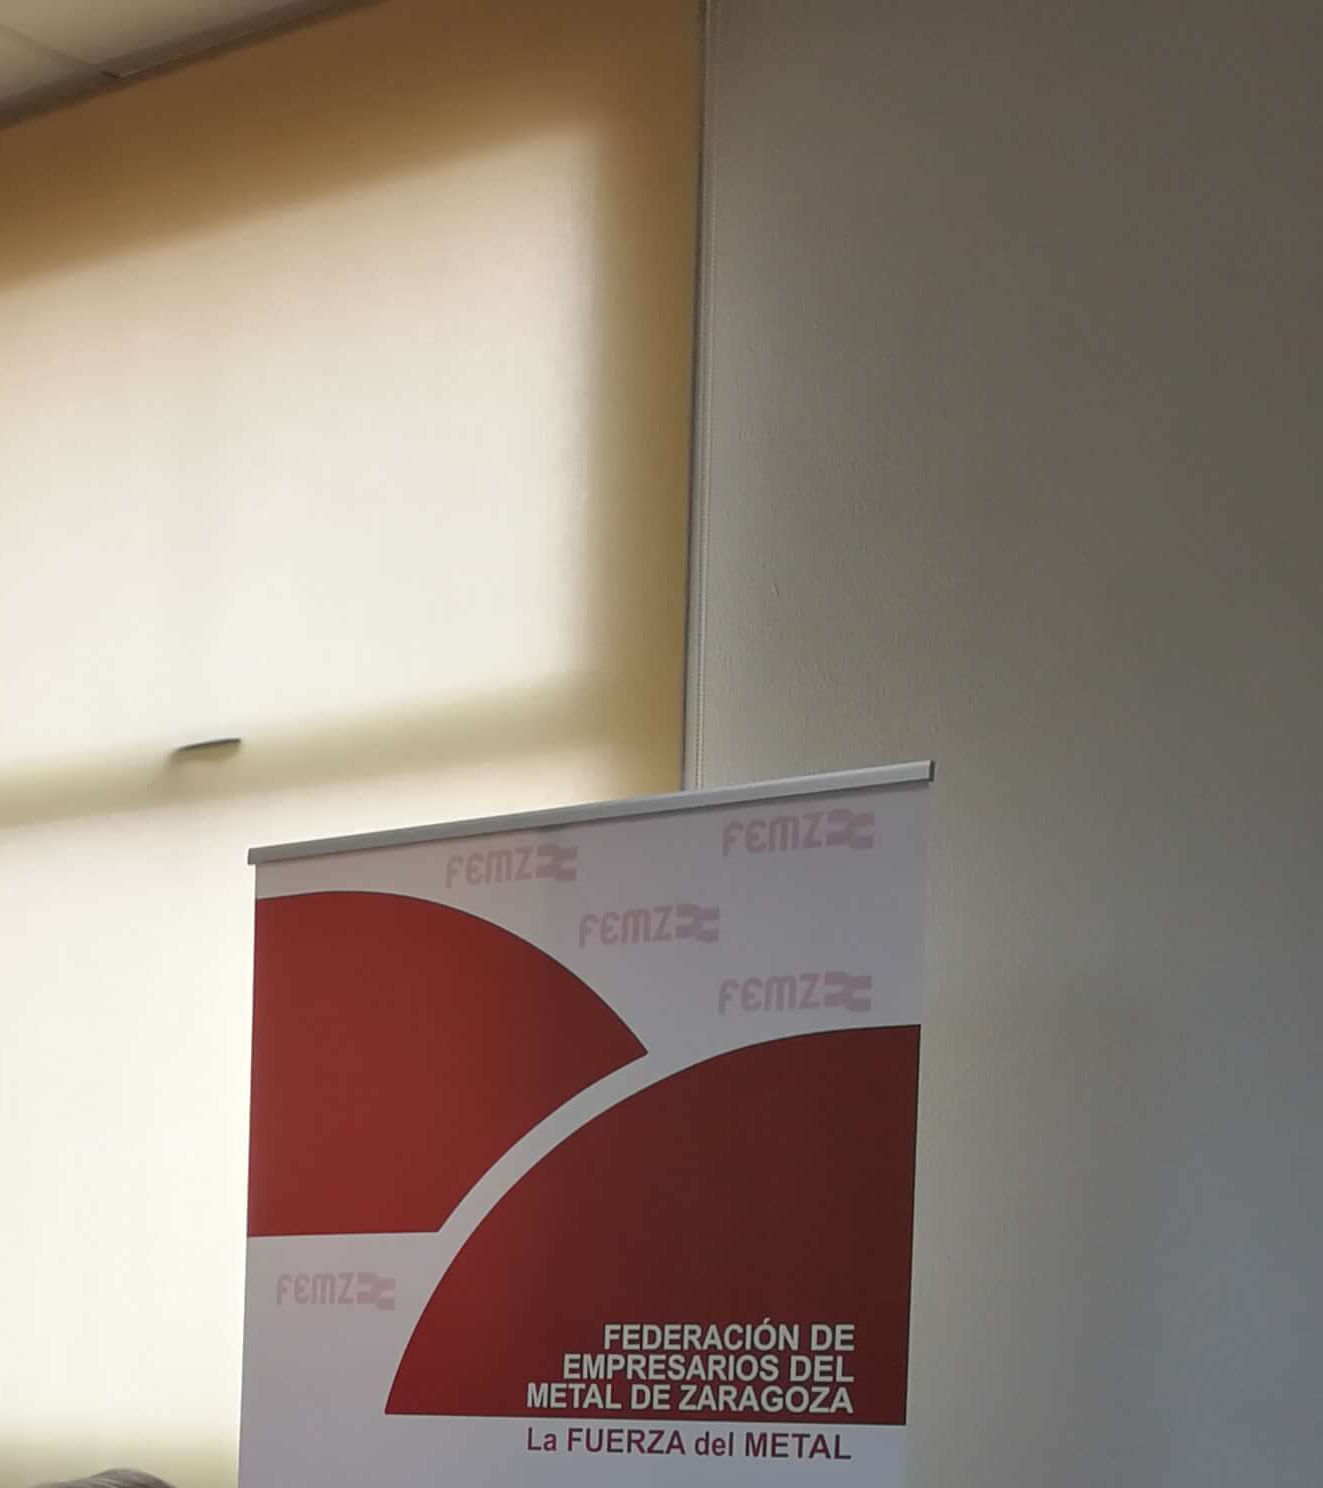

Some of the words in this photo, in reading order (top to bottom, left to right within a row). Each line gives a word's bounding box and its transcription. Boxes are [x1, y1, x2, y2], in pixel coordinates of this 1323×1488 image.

[603, 1319, 799, 1351] FEDERACIÓN
[810, 1324, 854, 1351] DE
[562, 1354, 779, 1383] EMPRESARIOS
[789, 1355, 854, 1384] DEL
[526, 1383, 623, 1410] METAL
[630, 1384, 671, 1411] DE
[679, 1384, 854, 1415] ZARAGOZA
[526, 1427, 557, 1453] La
[567, 1428, 686, 1456] FUERZA
[695, 1430, 734, 1458] del
[745, 1432, 852, 1461] METAL
